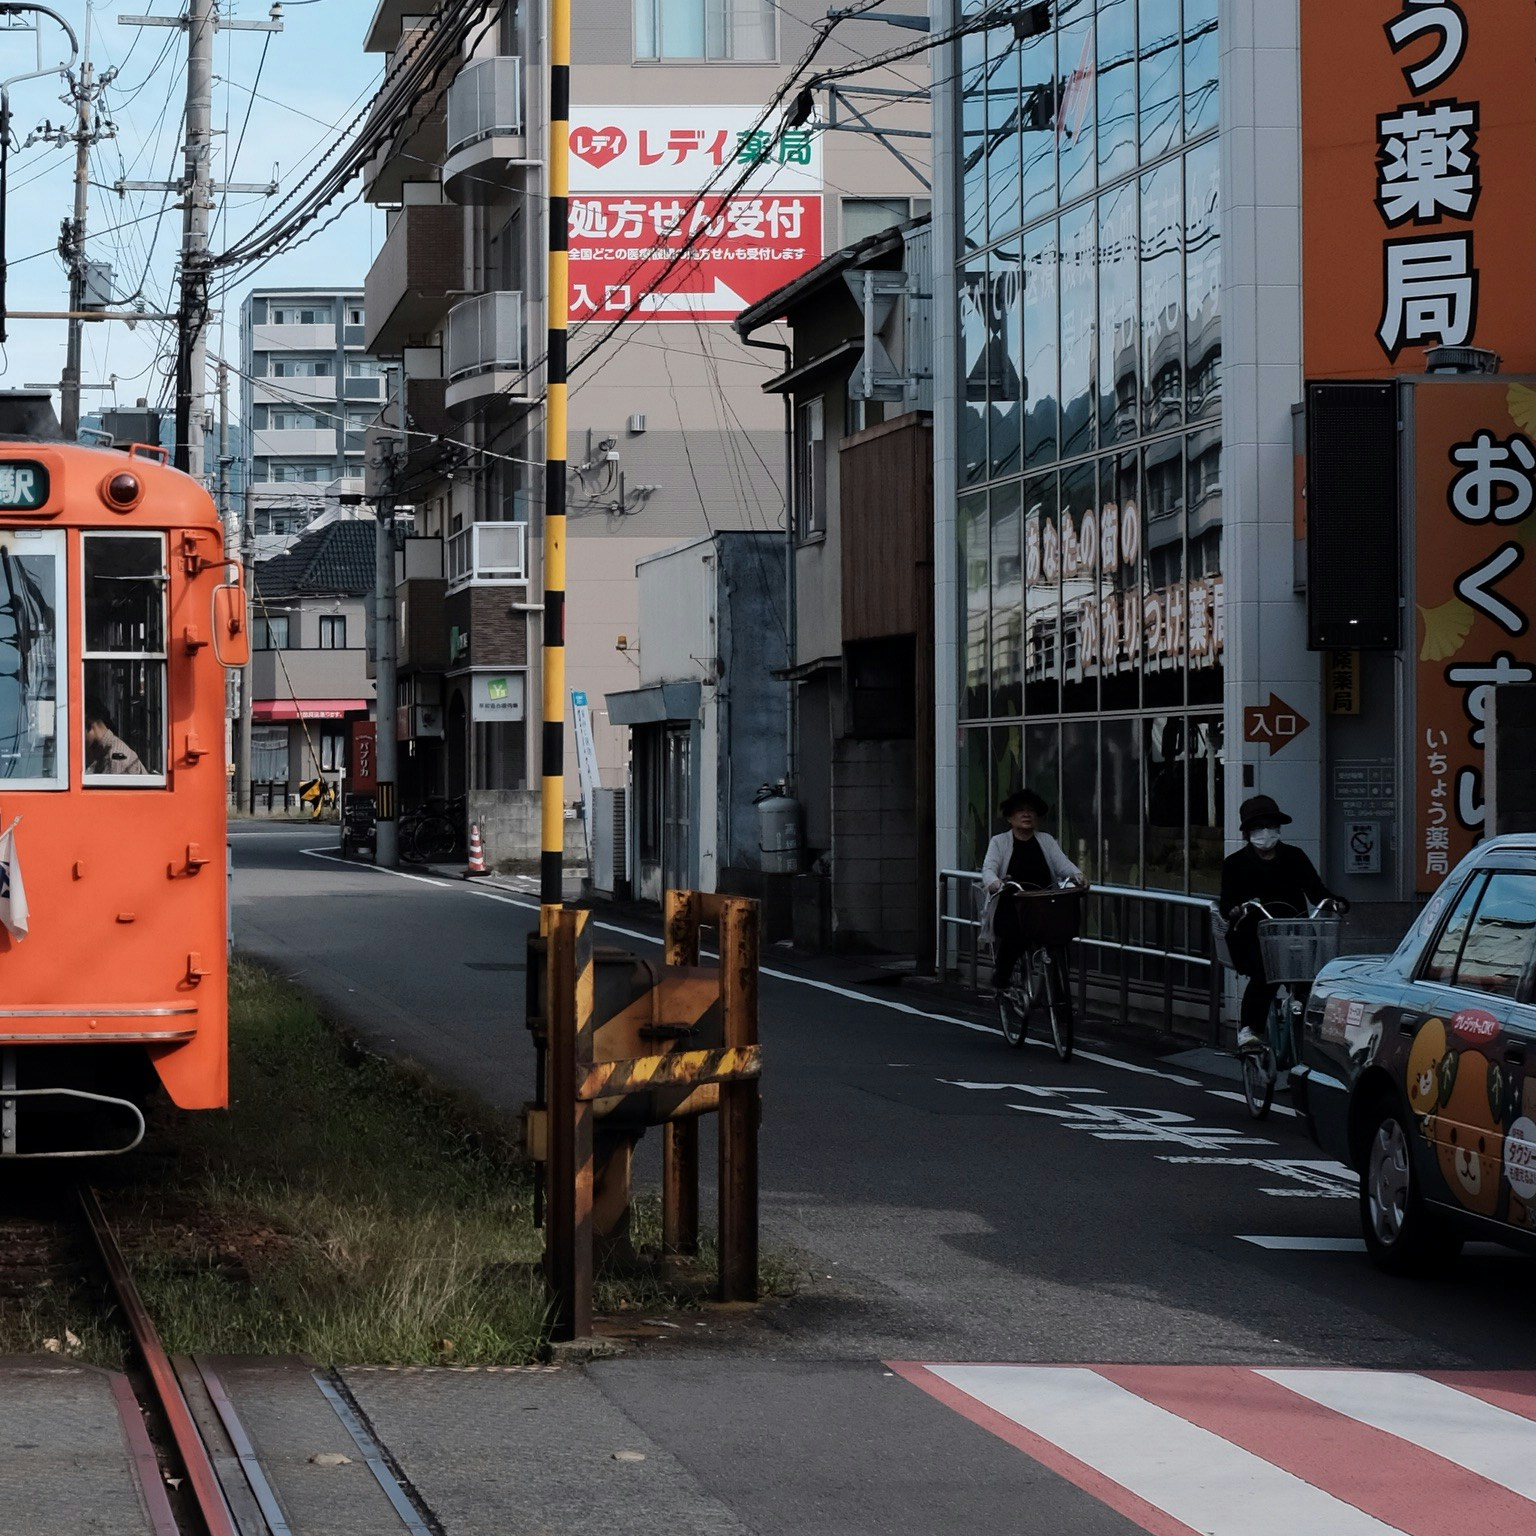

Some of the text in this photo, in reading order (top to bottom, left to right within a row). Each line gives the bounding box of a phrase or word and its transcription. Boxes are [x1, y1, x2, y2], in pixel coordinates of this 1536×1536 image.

[577, 135, 620, 155] レディ
[638, 130, 812, 166] レディ薬局
[568, 199, 805, 239] 処方せん受付
[570, 283, 631, 312] 入口
[1250, 711, 1297, 737] 入口
[1426, 727, 1450, 876] いちょう薬局
